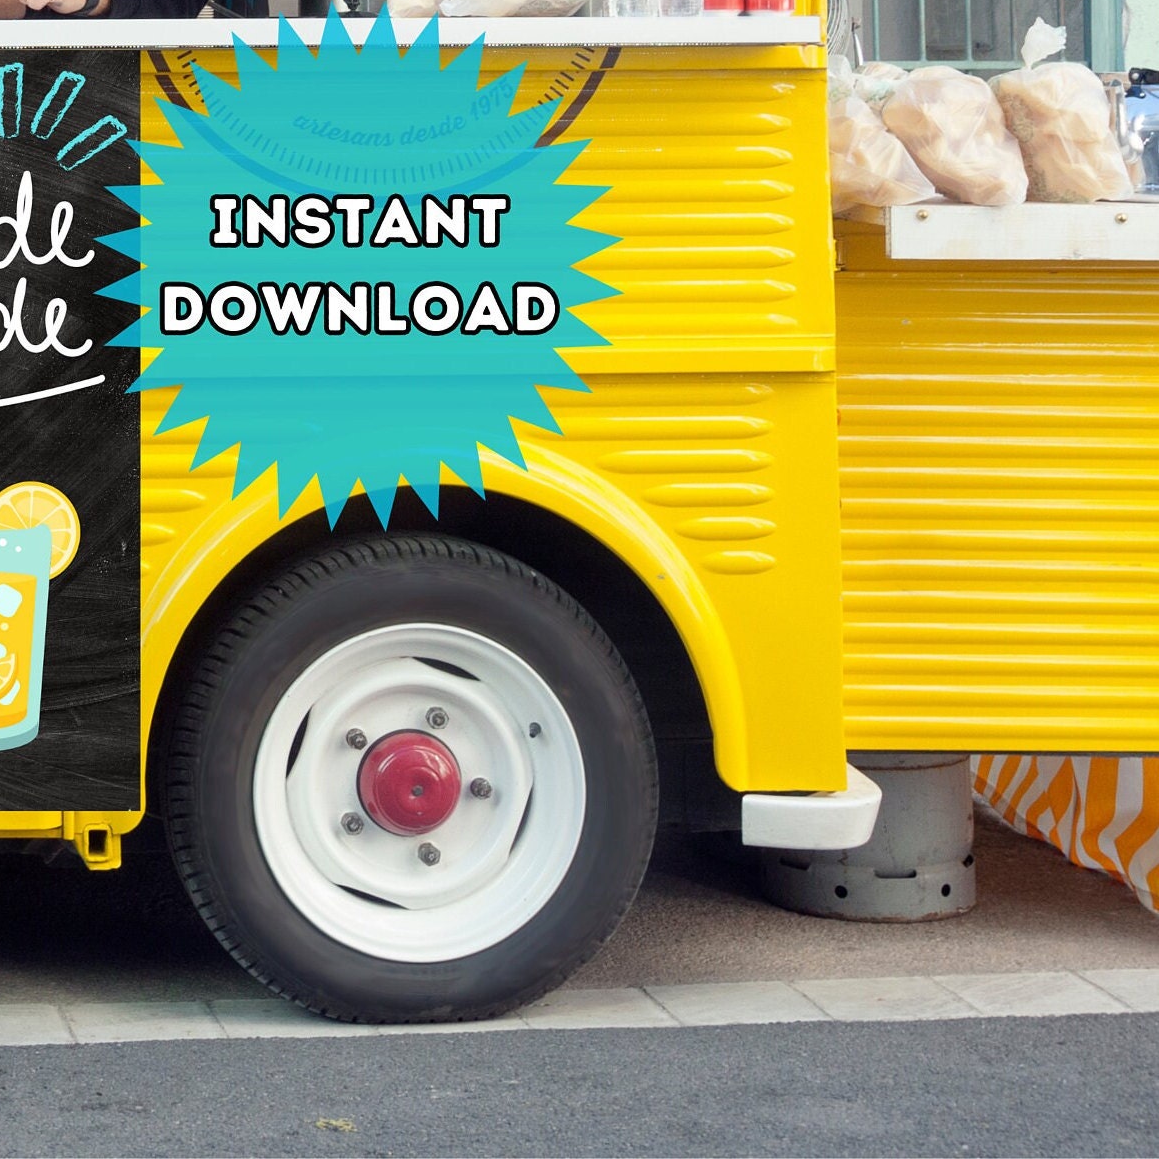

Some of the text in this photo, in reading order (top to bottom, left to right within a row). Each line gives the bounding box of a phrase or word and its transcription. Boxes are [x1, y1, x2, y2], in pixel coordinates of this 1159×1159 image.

[293, 76, 515, 147] artesans desde 1975
